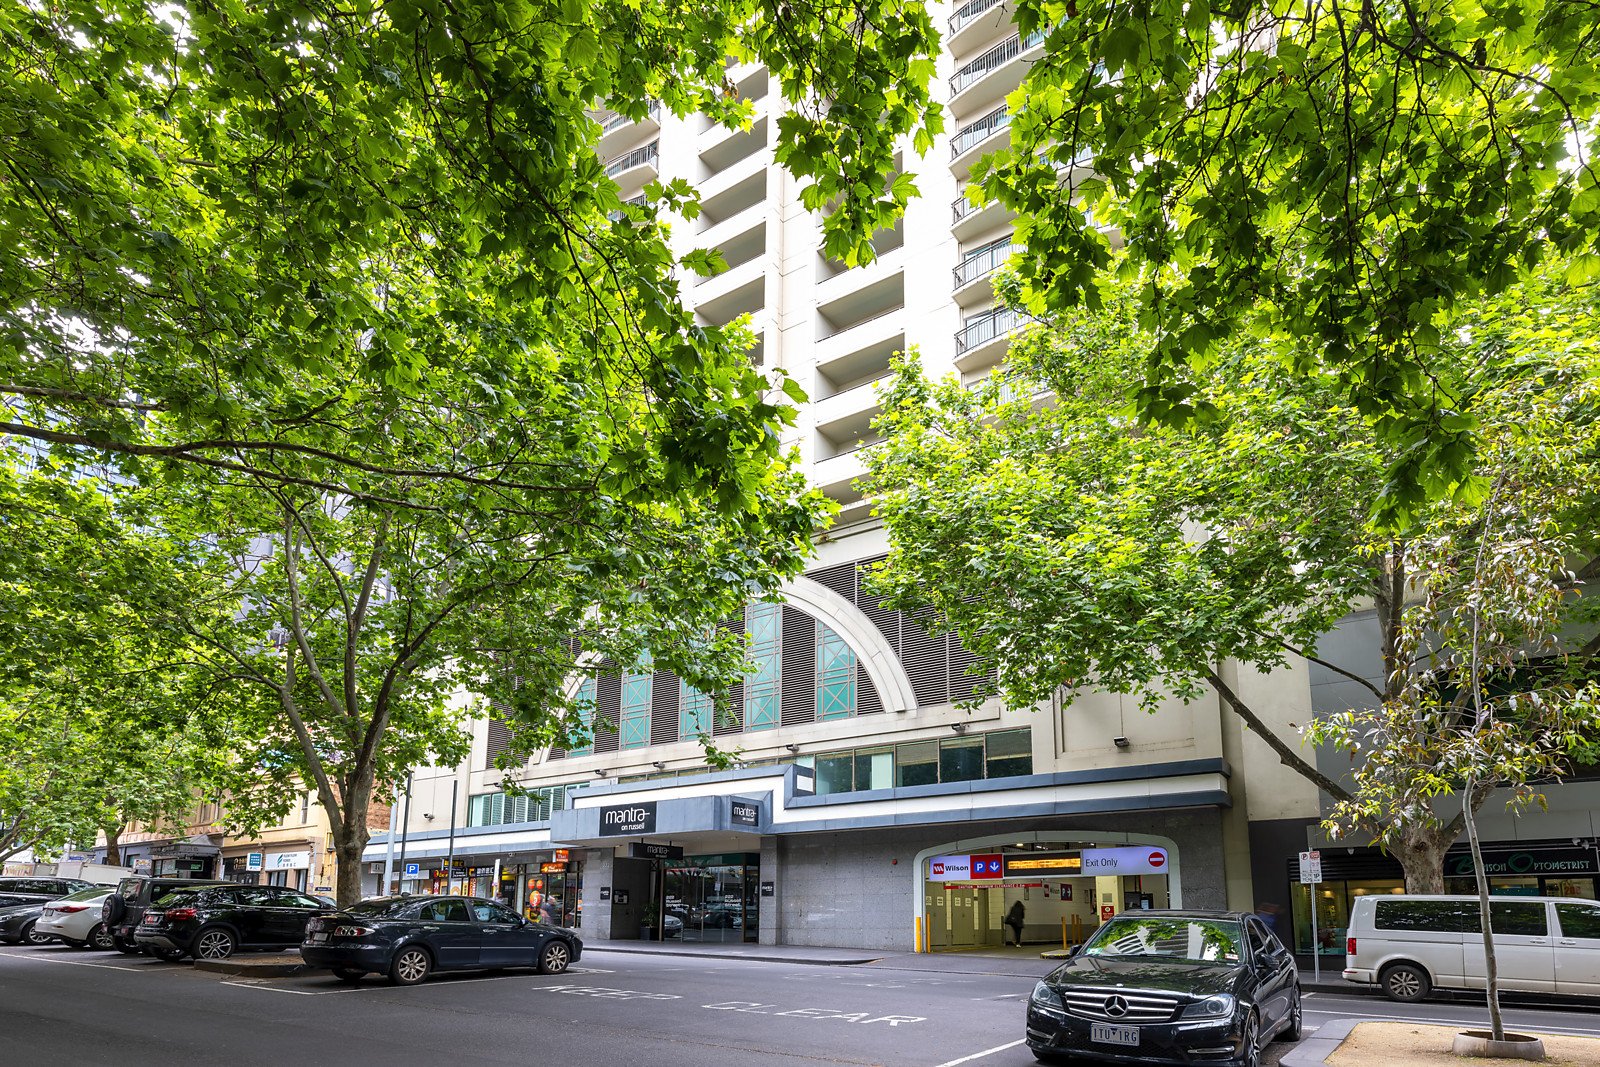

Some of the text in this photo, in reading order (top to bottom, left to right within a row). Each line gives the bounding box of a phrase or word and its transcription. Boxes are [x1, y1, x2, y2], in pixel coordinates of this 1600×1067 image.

[605, 807, 650, 824] mantra
[733, 806, 756, 818] mantra
[647, 845, 670, 854] mantra
[976, 863, 983, 871] P
[1085, 859, 1099, 867] Exit
[1101, 858, 1118, 868] Only
[409, 865, 416, 873] P
[532, 984, 683, 1000] KEEP
[701, 1001, 928, 1026] CLEAR
